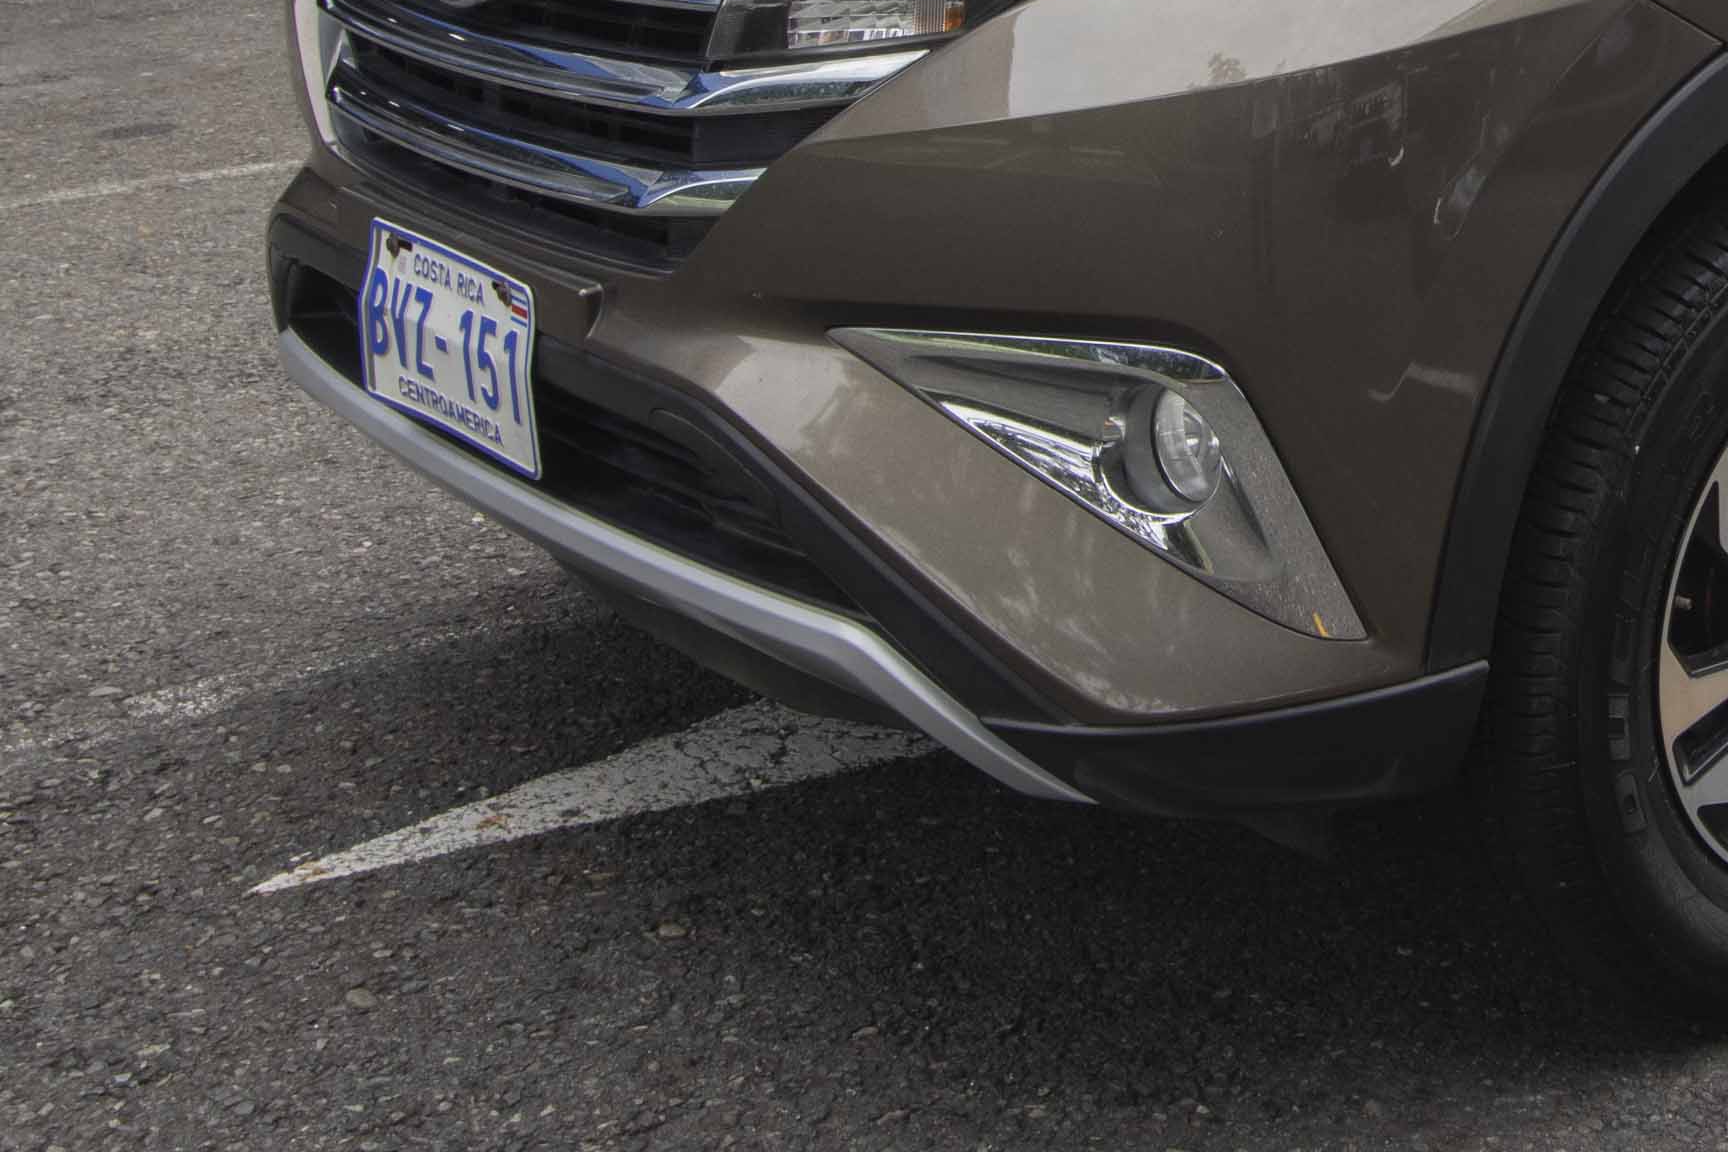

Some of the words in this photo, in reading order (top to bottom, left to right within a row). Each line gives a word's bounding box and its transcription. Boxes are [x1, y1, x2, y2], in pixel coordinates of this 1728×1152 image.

[413, 253, 452, 290] COSTA
[456, 274, 485, 305] RICA
[369, 267, 521, 425] BYZ-151
[398, 377, 503, 445] CENTROAMERICA
